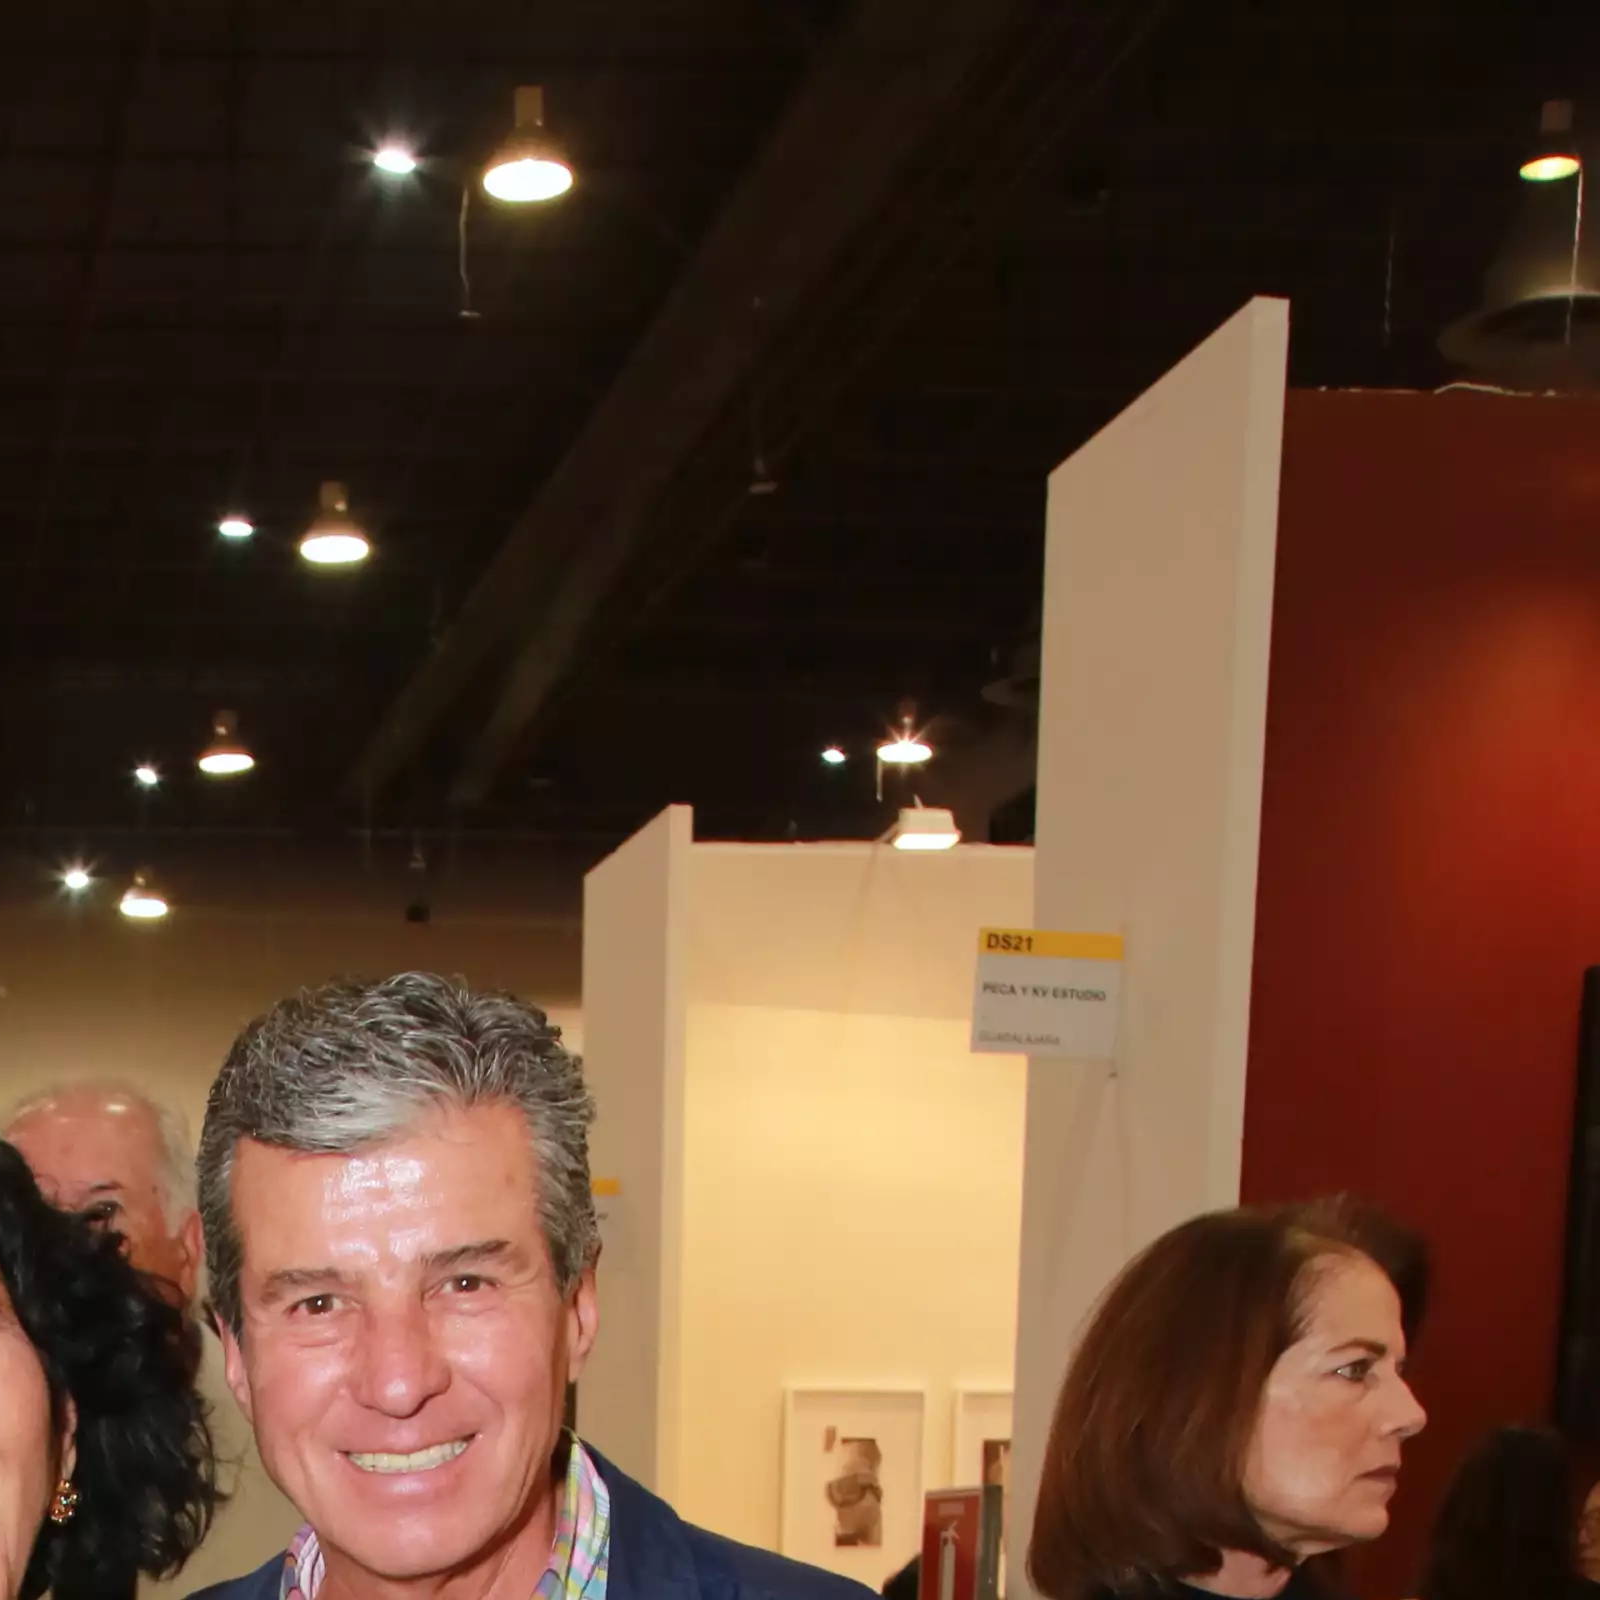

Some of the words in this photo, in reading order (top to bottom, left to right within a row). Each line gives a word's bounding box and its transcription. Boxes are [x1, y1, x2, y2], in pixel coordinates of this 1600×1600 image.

[985, 932, 1034, 951] DS21
[982, 981, 1017, 996] PECA
[1052, 988, 1106, 1001] ESTUDIO
